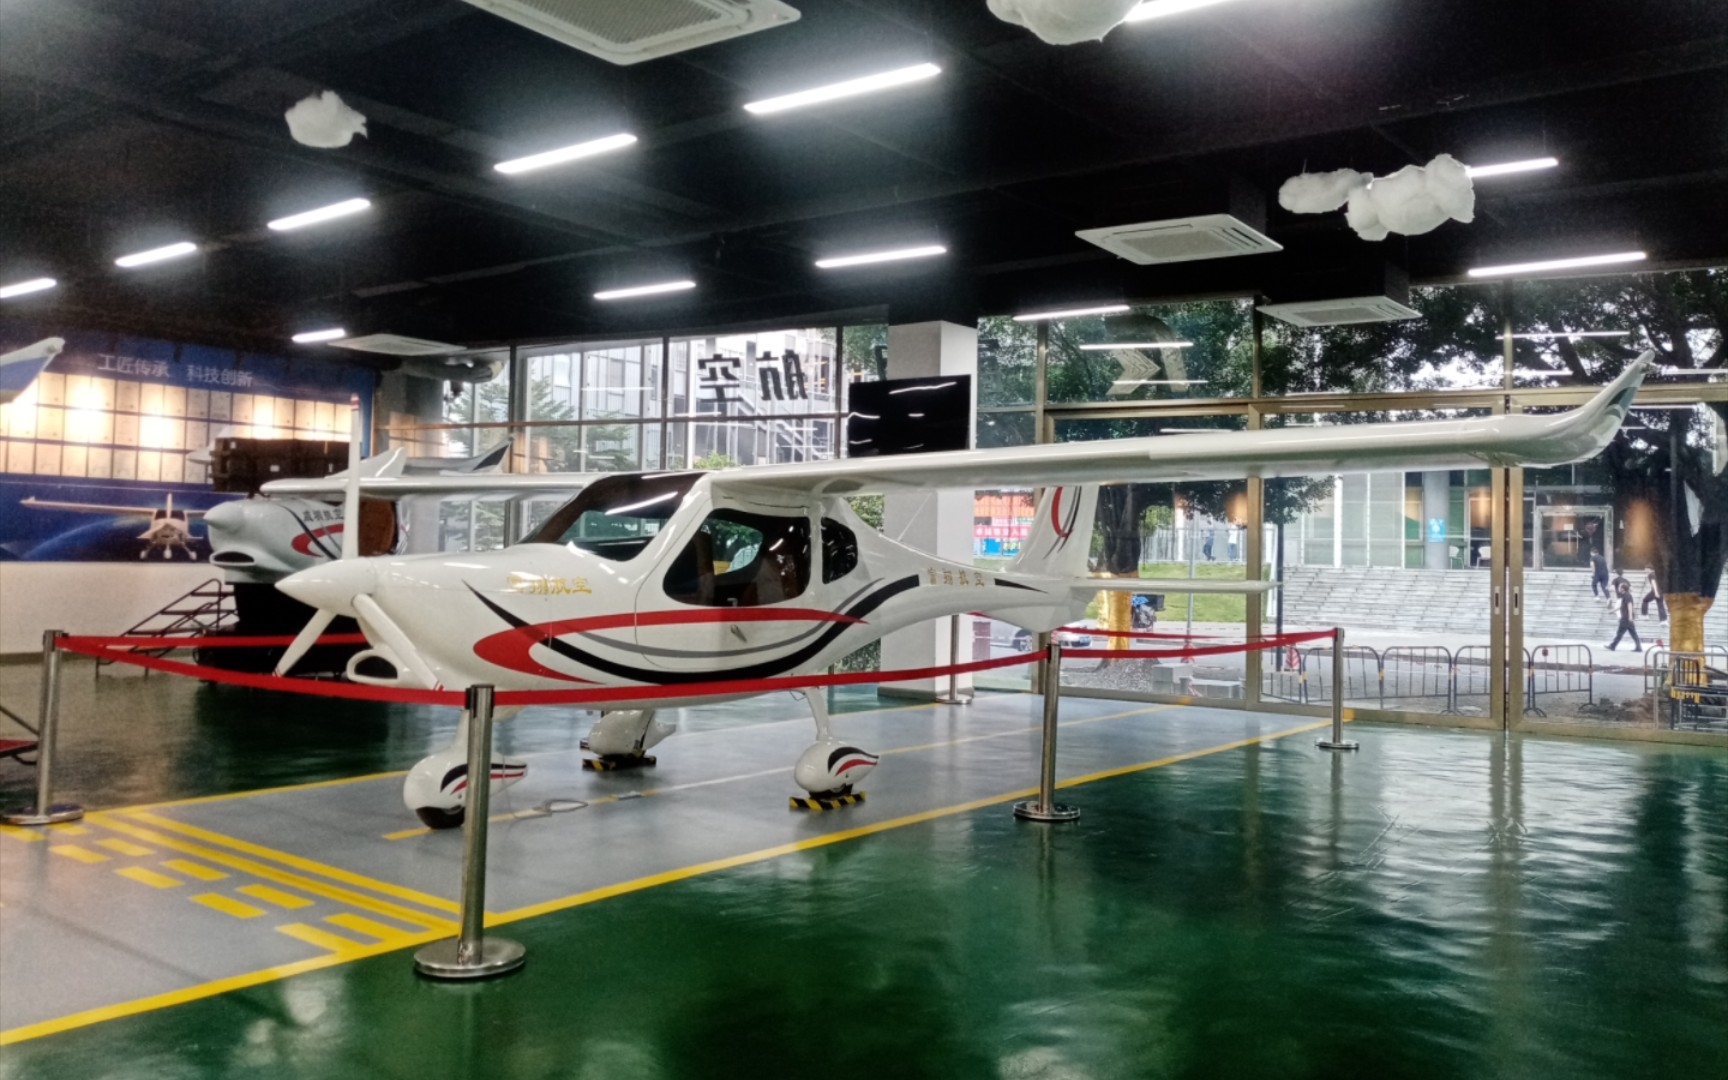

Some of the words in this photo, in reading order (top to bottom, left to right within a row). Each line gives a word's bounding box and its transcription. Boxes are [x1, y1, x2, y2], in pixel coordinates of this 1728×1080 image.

[97, 353, 170, 378] 工匠传承
[186, 364, 254, 387] 科技创新
